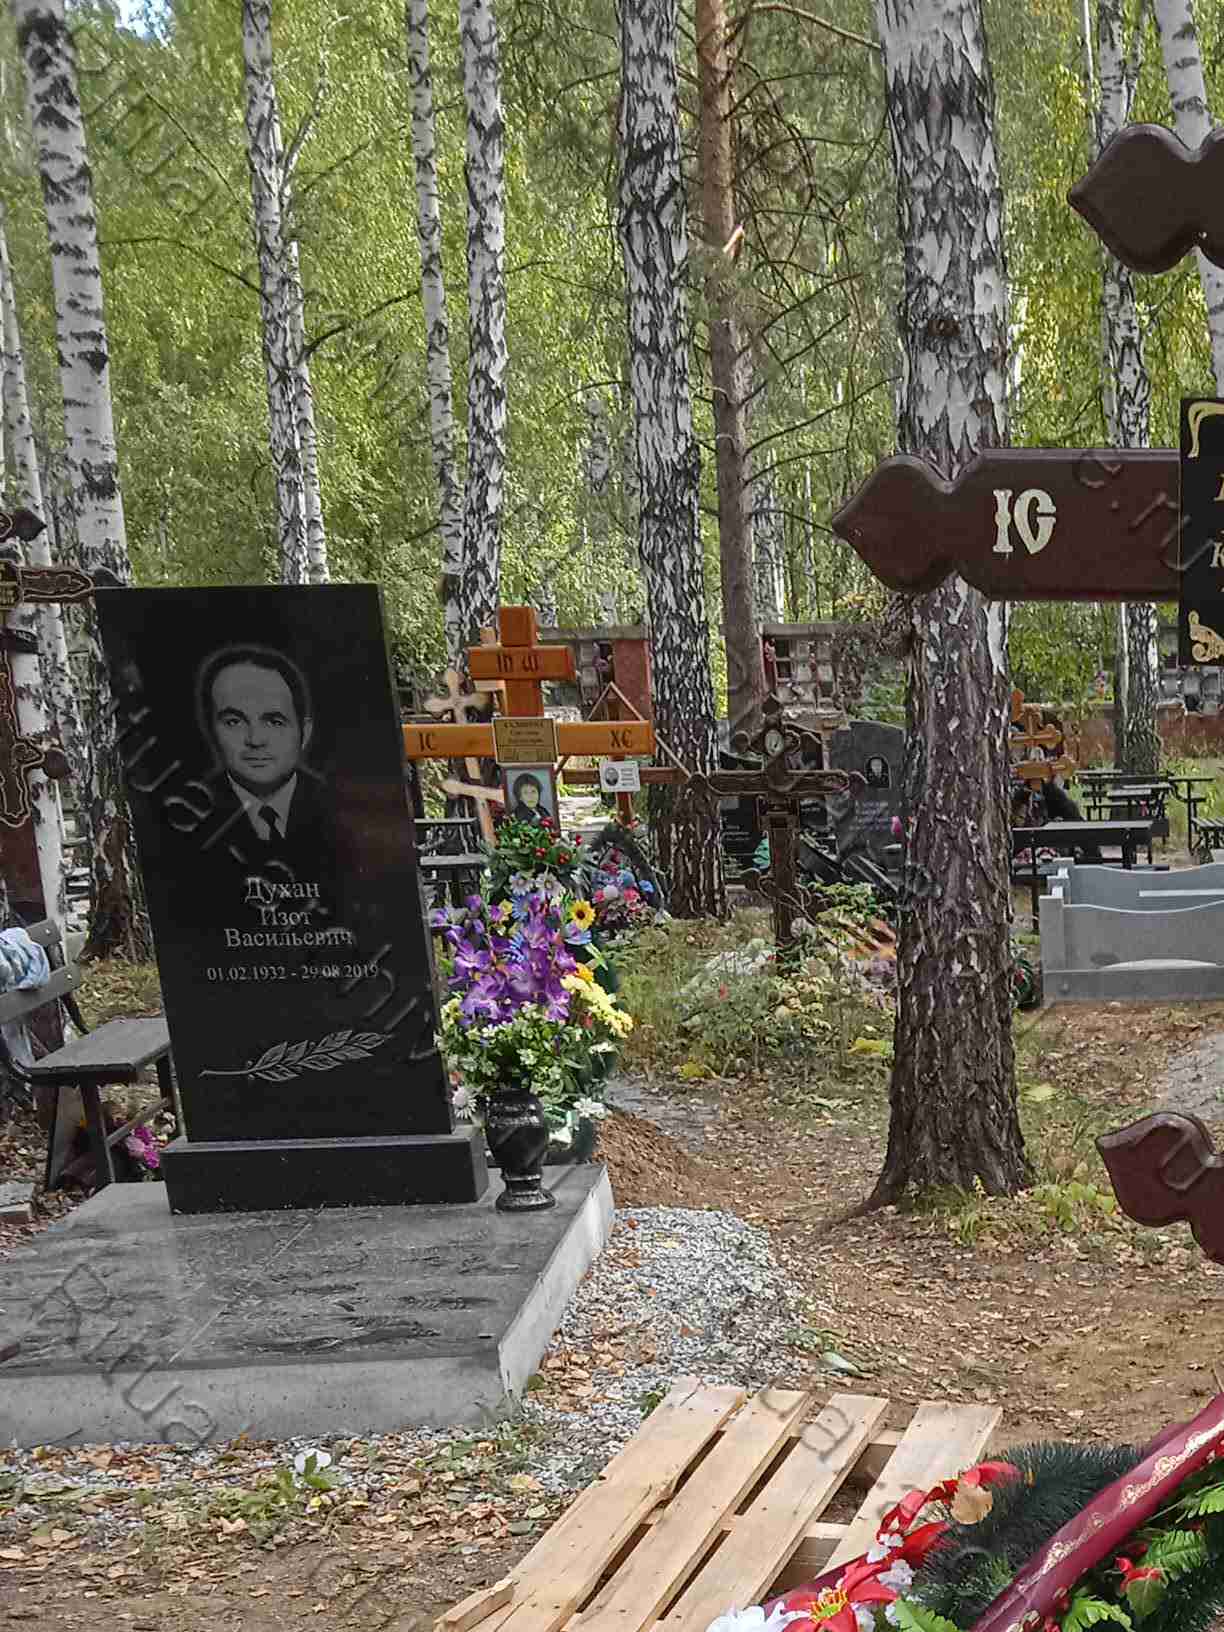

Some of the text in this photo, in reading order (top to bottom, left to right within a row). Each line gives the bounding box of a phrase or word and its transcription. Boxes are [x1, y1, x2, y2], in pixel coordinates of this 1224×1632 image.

[245, 877, 321, 904] Духан
[258, 906, 313, 926] Изот
[223, 928, 355, 947] Васильевич
[207, 966, 286, 981] 01.02.1932
[301, 963, 378, 980] 29.08.2019
